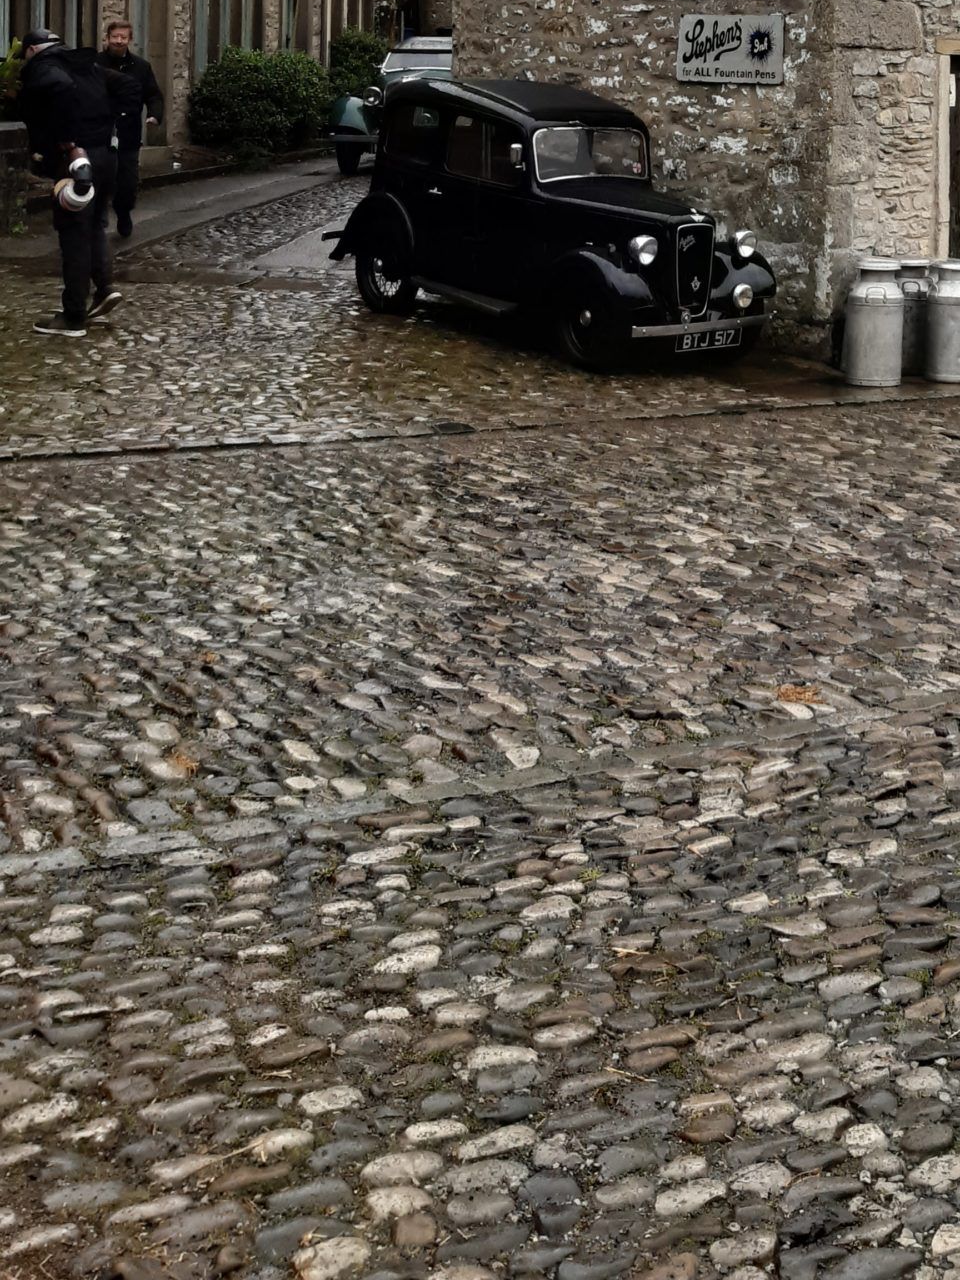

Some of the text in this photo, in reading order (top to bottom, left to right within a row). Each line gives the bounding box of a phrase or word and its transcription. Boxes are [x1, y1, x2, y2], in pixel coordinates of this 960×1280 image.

[682, 66, 777, 80] for ALL Fountain Pens
[682, 329, 736, 350] BTJ 517
